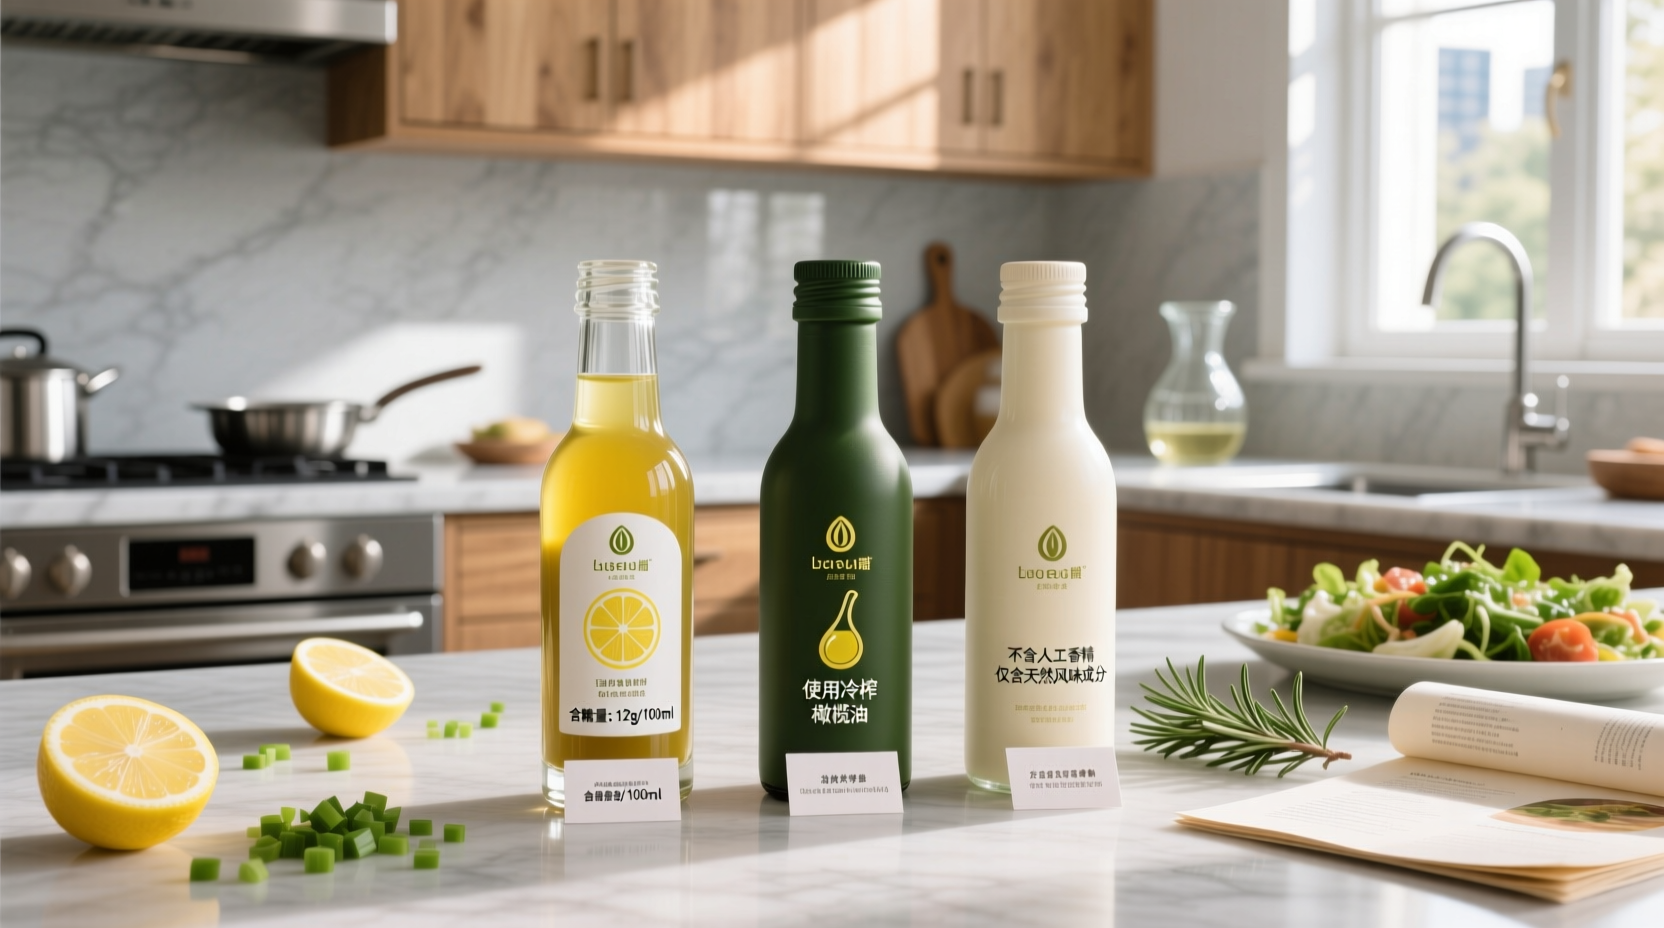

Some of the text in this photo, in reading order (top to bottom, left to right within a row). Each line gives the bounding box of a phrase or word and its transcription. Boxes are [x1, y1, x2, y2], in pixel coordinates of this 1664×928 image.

[802, 678, 878, 700] 使用冷榨
[811, 703, 868, 726] 橄榄油
